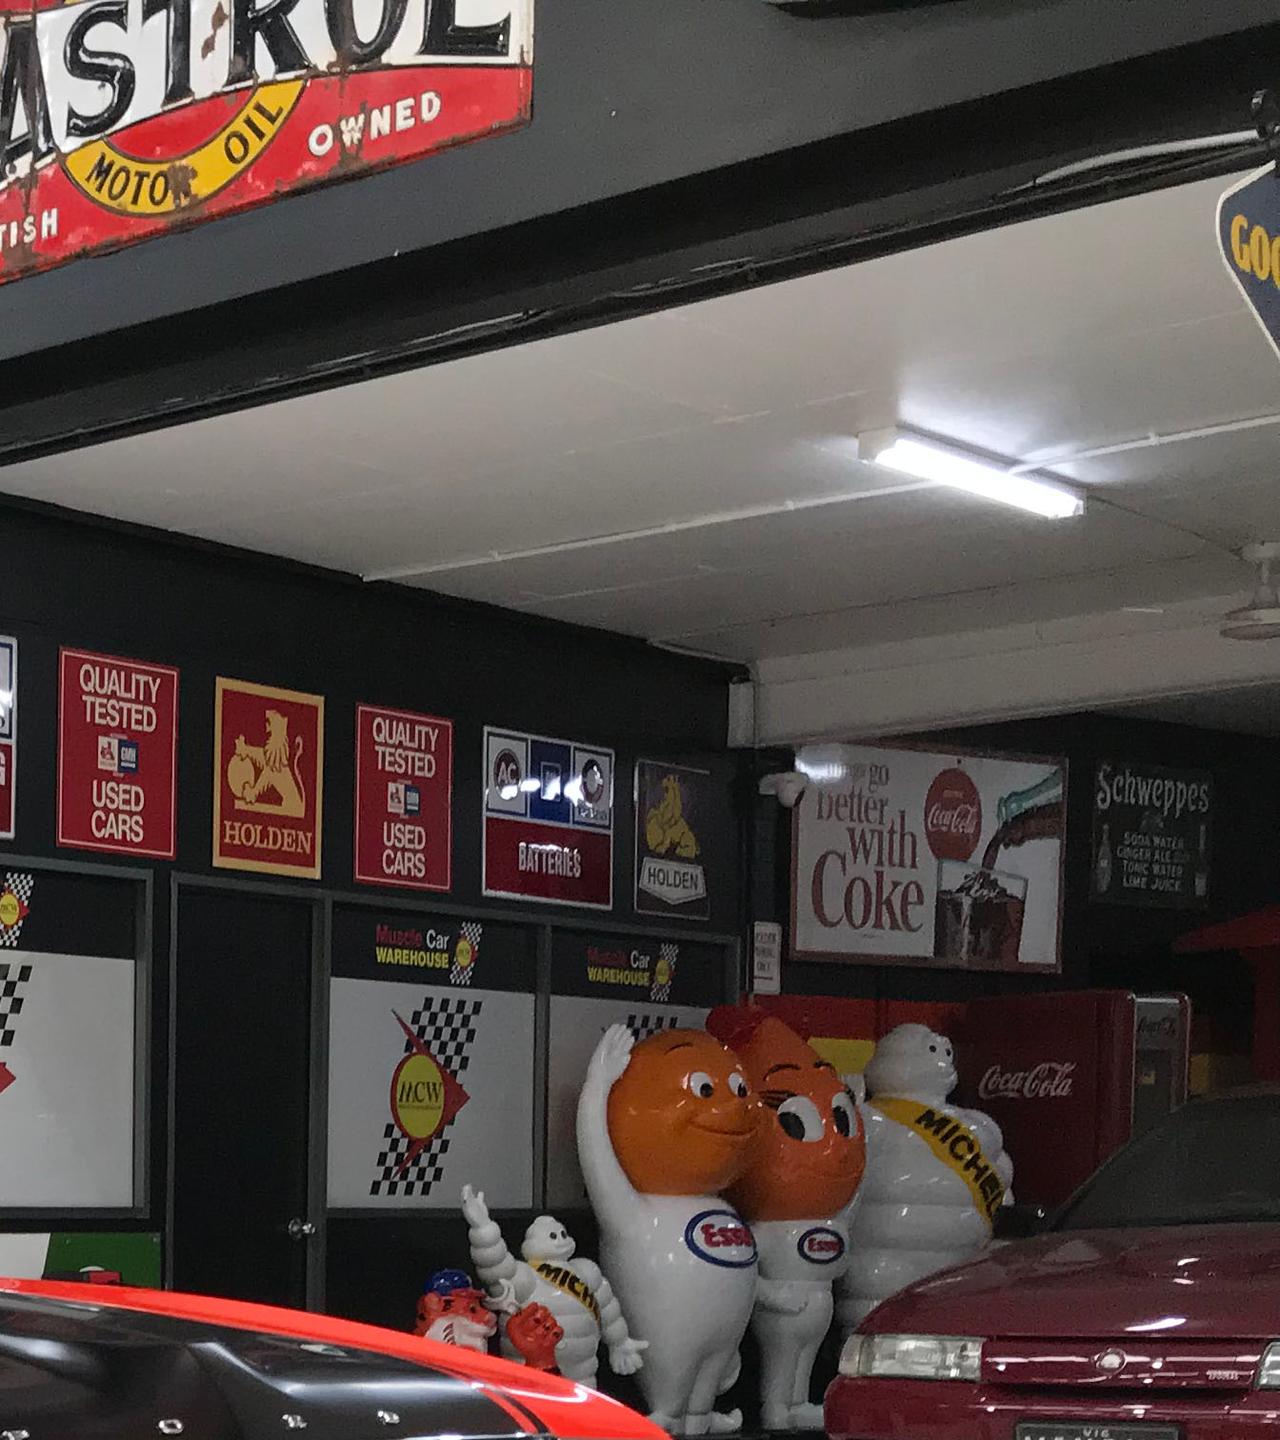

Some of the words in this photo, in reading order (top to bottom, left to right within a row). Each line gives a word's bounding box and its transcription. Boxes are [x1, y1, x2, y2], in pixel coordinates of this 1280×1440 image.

[307, 90, 442, 157] OWNED
[85, 151, 197, 208] MOTO
[223, 100, 283, 166] OIL
[78, 662, 161, 705] QUALITY
[81, 693, 157, 734] TESTED
[372, 716, 439, 753] QUALITY
[374, 745, 436, 780] TESTED
[92, 778, 145, 813] USED
[1096, 764, 1209, 819] Schweppes
[90, 809, 144, 844] CARS
[223, 819, 313, 856] HOLDEN
[382, 821, 426, 851] USED
[847, 809, 918, 870] with
[381, 849, 426, 879] CARS
[518, 841, 582, 879] BATTERIES
[646, 867, 699, 892] HOLDEN
[811, 849, 925, 933] Coke
[426, 928, 450, 950] Car
[375, 945, 449, 969] WAREHOUSE
[630, 949, 651, 969] Car
[587, 965, 650, 987] WAREHOUSE
[398, 1080, 443, 1103] MCW
